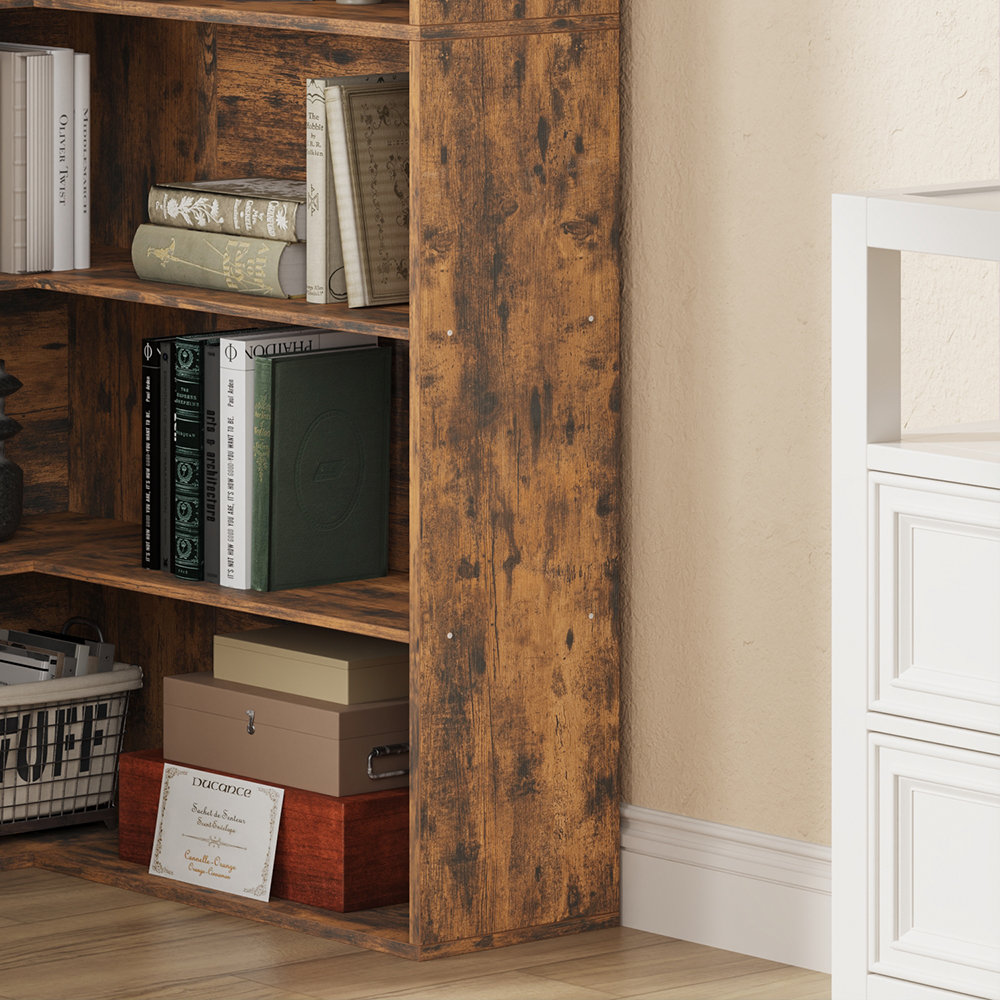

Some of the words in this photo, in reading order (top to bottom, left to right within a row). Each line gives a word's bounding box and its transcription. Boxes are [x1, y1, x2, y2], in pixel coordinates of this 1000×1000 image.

[308, 112, 320, 121] The
[227, 379, 235, 394] Arden
[227, 395, 235, 407] Paul
[206, 410, 216, 433] arts
[227, 425, 235, 433] TO
[227, 434, 235, 449] WANT
[206, 451, 219, 523] architecture
[227, 478, 235, 490] HOW
[227, 516, 235, 527] YOU
[227, 543, 235, 556] HOW
[227, 557, 235, 568] NOT
